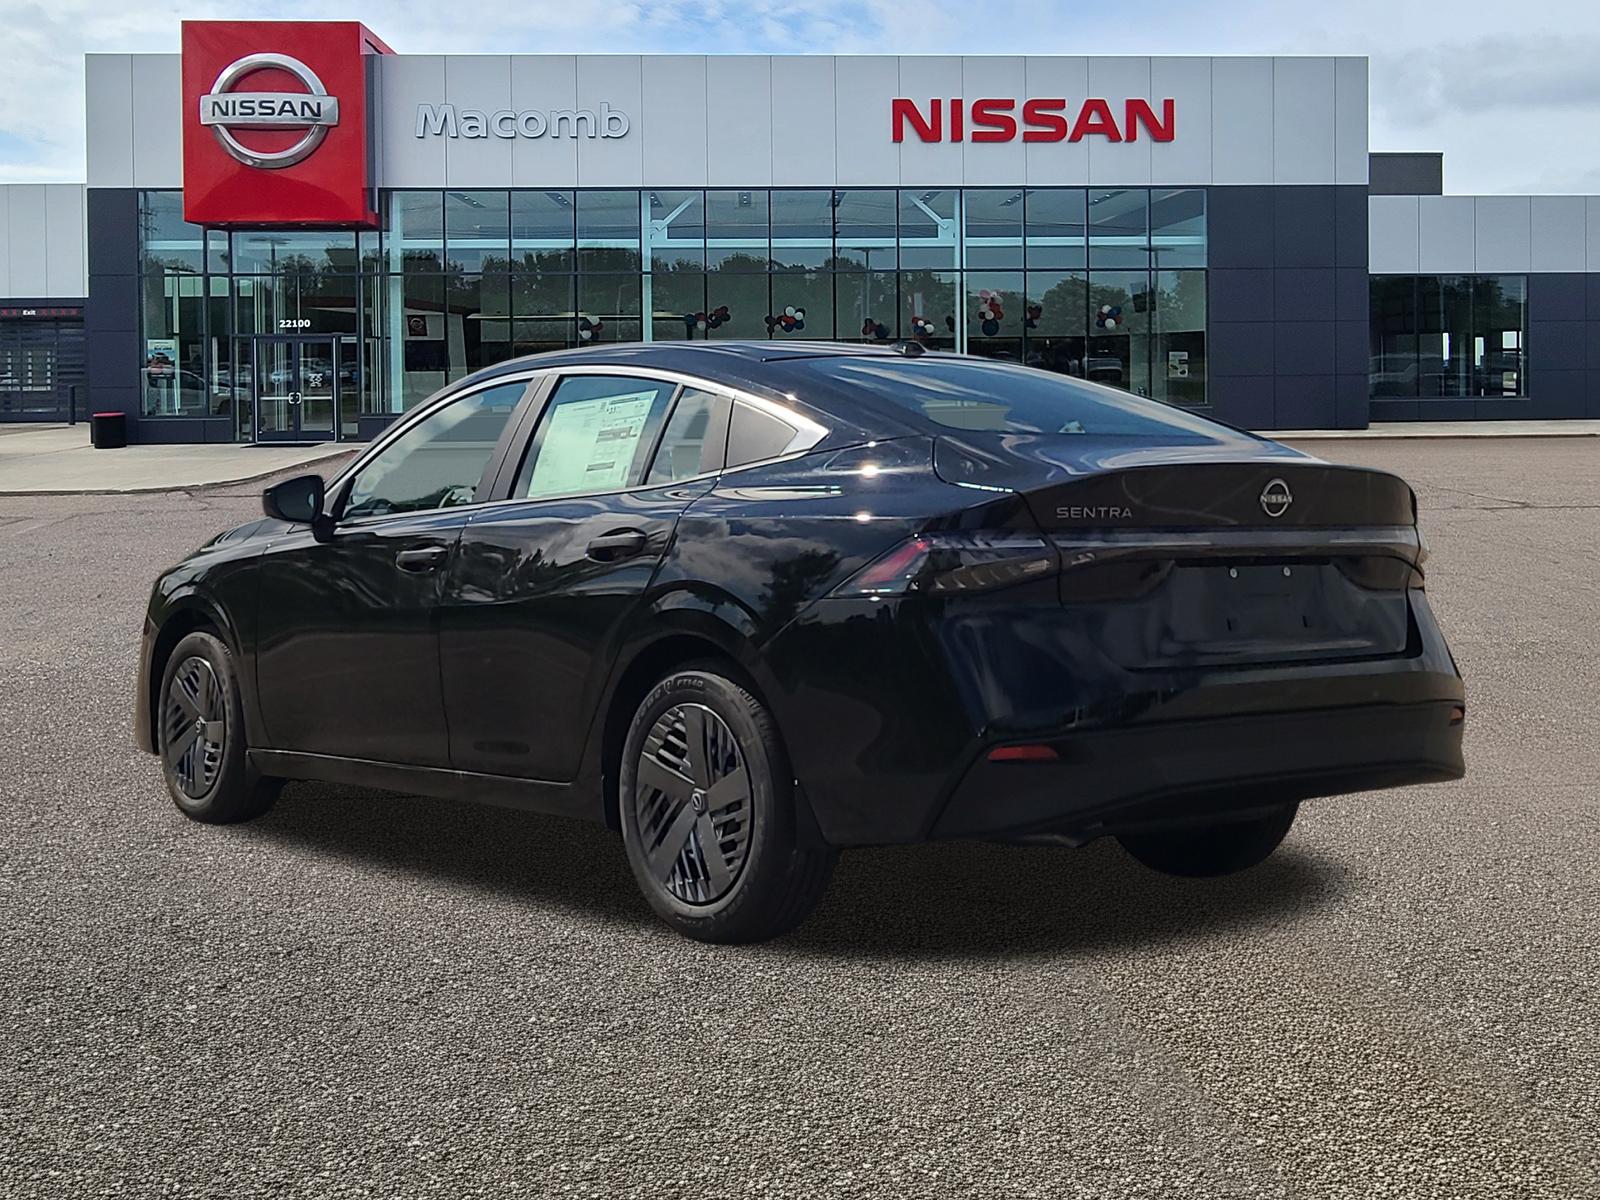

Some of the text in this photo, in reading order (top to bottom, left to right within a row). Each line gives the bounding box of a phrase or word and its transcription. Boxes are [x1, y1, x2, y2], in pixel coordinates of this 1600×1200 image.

[211, 100, 322, 117] NISSAN
[415, 102, 630, 139] Macomb
[892, 98, 1175, 143] NISSAN
[279, 319, 311, 328] 22100
[1260, 494, 1293, 503] NISSAN
[1056, 507, 1133, 519] SENTRA
